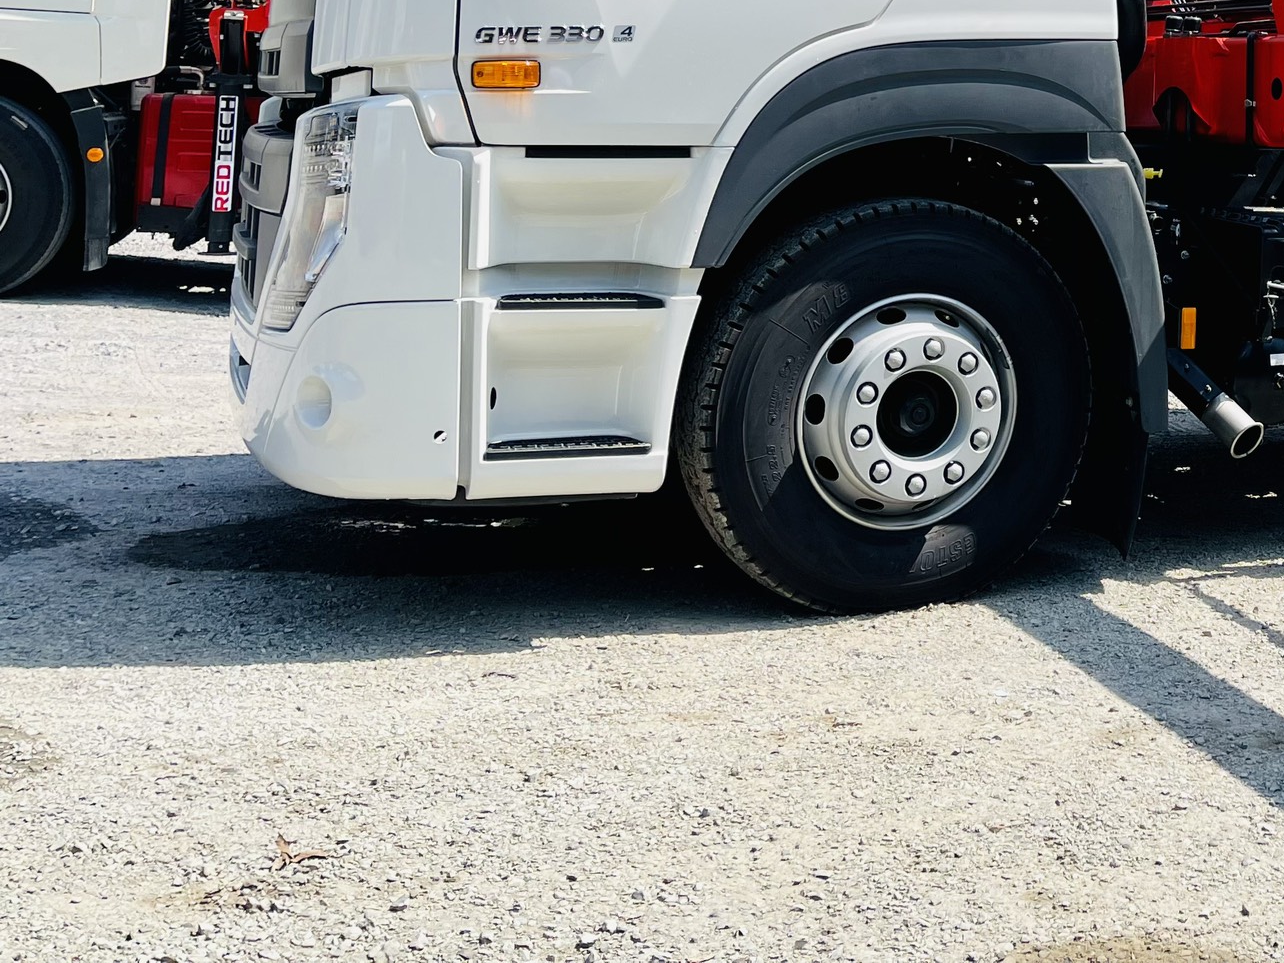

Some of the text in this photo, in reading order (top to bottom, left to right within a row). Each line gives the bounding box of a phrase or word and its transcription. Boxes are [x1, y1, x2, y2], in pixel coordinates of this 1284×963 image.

[475, 24, 633, 44] GWE 330 4
